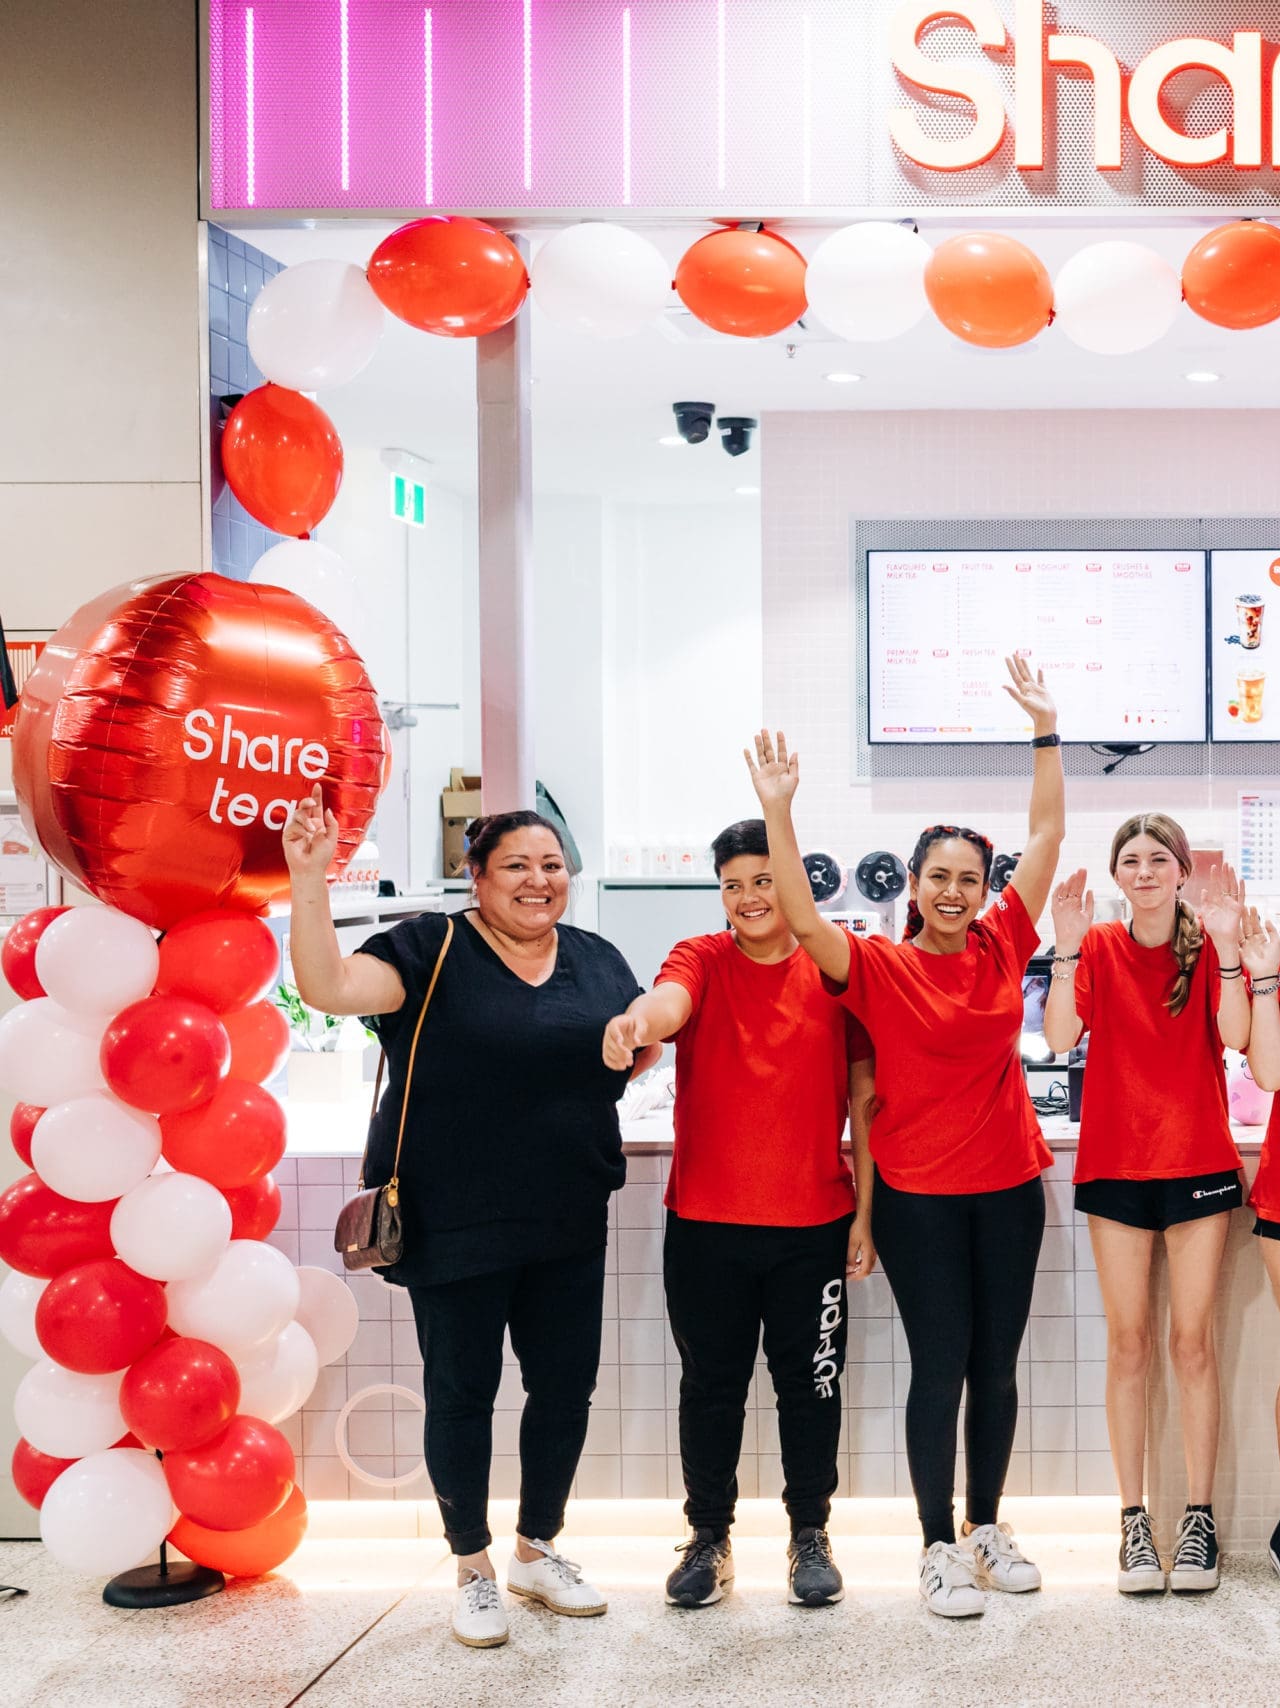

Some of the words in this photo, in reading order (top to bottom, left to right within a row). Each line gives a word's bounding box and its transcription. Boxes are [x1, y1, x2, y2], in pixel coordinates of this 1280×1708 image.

[886, 563, 927, 572] FLAVOURED
[961, 563, 981, 572] FRUIT
[982, 563, 994, 572] TEA
[1112, 562, 1142, 571] CRUSHES
[886, 572, 903, 580] MILK
[905, 572, 918, 580] TEA
[886, 649, 919, 657] PREMIUM
[961, 649, 983, 657] FRESH
[984, 649, 996, 657] TEA
[886, 657, 903, 665] MILK
[905, 657, 918, 665] TEA
[183, 708, 330, 780] Share
[209, 777, 298, 831] tea
[1192, 1184, 1237, 1199] Champion
